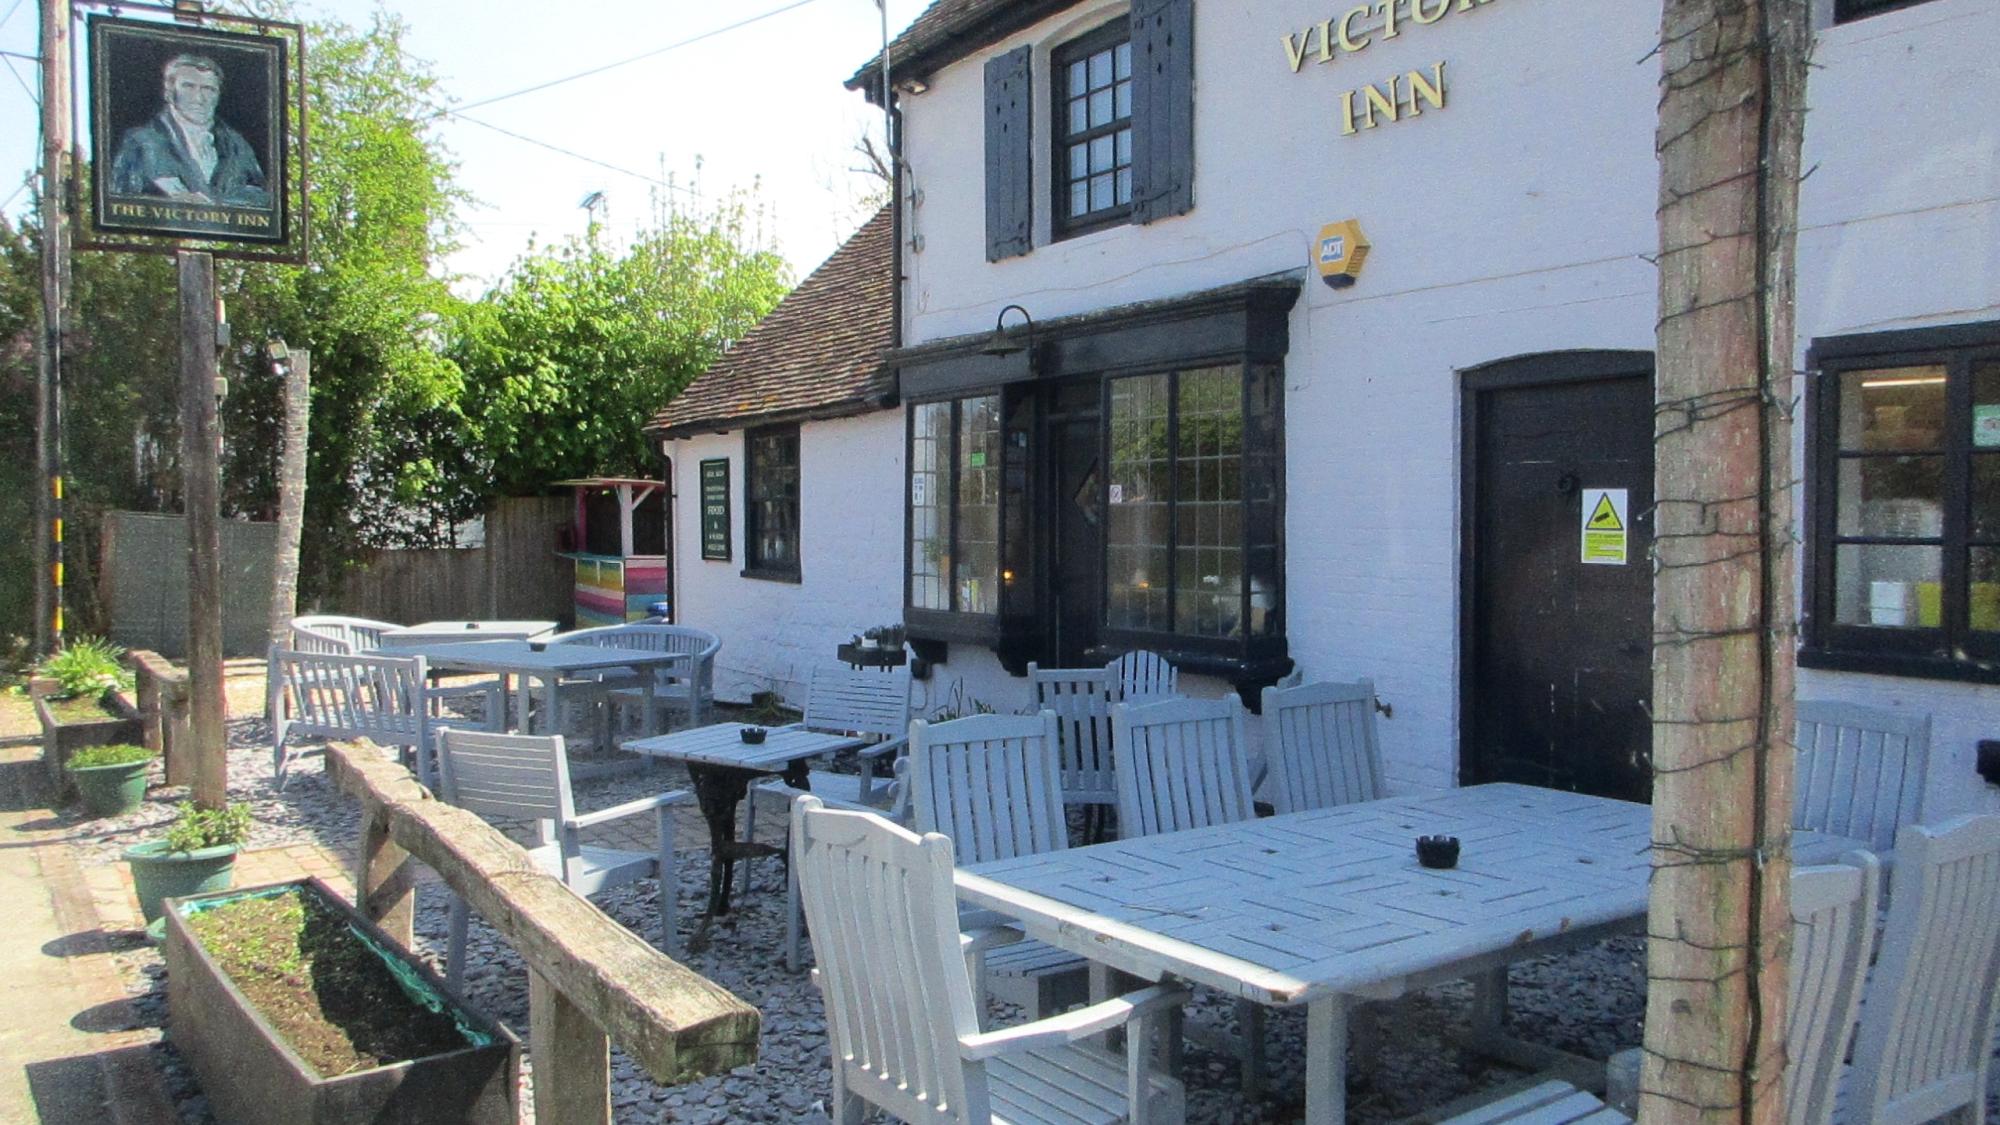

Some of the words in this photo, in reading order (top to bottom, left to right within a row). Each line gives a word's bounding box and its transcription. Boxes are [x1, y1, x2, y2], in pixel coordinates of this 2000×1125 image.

[1338, 60, 1446, 136] INN
[111, 203, 146, 217] THE
[152, 206, 231, 224] VICTORY
[237, 213, 270, 227] INN
[1322, 241, 1344, 256] ADT
